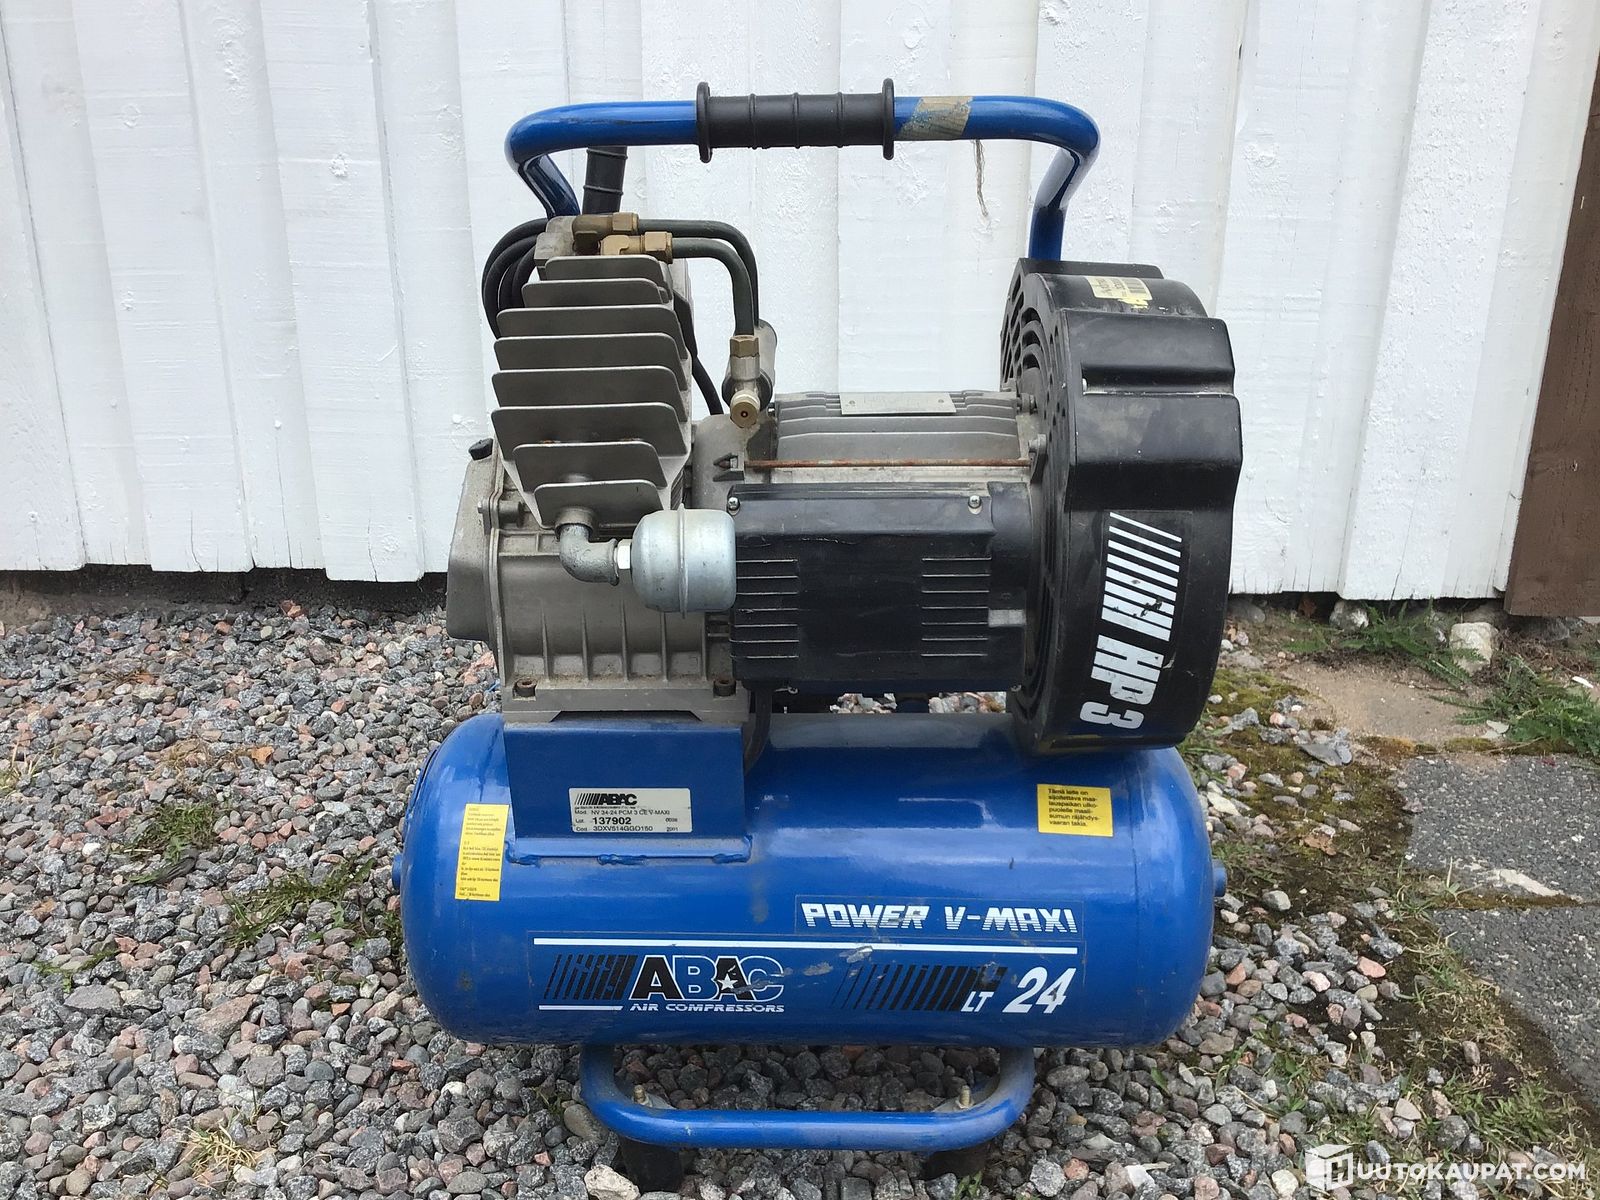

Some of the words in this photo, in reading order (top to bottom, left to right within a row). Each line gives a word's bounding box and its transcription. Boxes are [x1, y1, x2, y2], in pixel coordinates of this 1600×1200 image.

[1090, 634, 1165, 706] HP
[1079, 701, 1144, 730] 3
[597, 793, 638, 806] ABAC
[592, 817, 632, 825] 137902
[801, 902, 931, 930] POWER
[944, 906, 1079, 933] V-MAXI
[628, 954, 785, 1003] ABAC
[960, 991, 995, 1013] LT
[1002, 966, 1077, 1015] 24
[629, 1003, 659, 1011] AIR
[665, 1003, 785, 1013] COMPRESSORS
